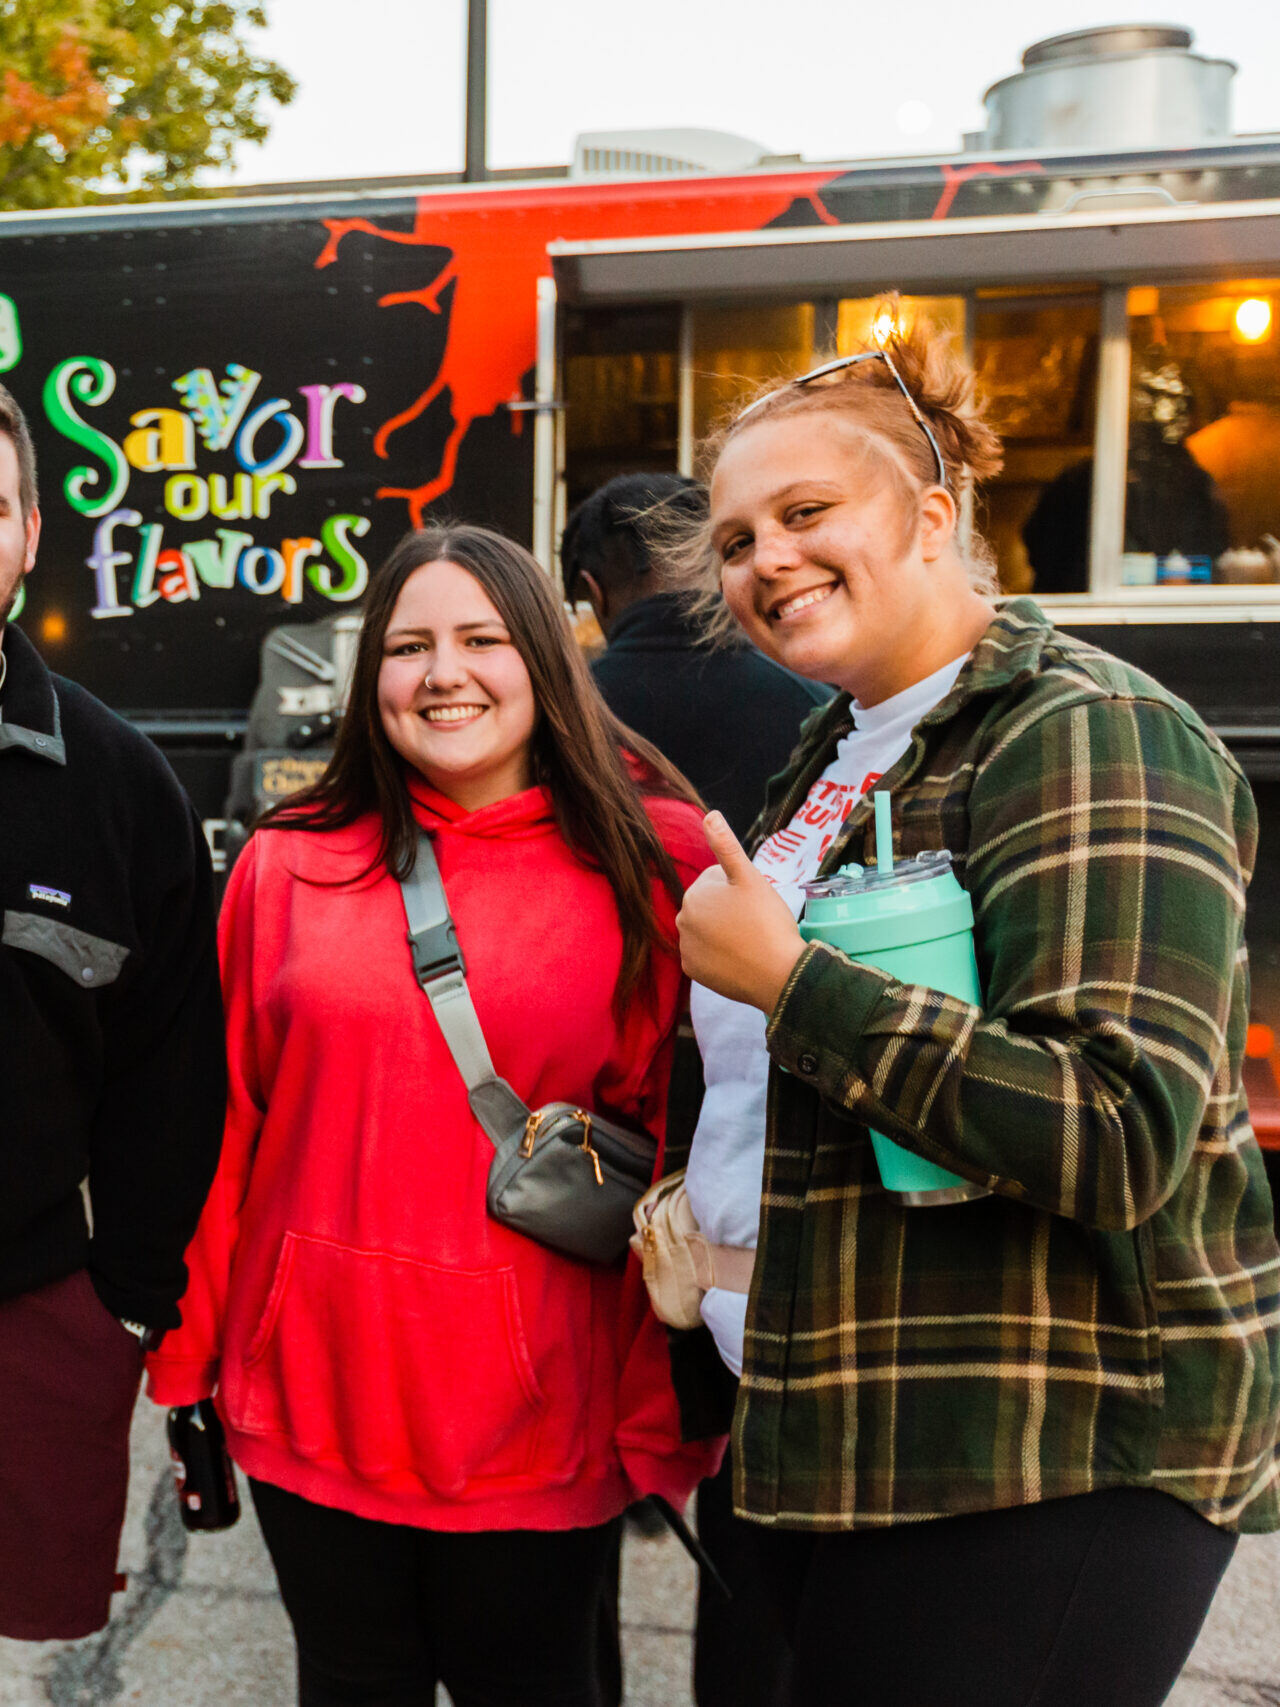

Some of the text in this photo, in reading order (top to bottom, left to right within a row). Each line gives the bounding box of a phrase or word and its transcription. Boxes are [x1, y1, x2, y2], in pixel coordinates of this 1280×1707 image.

[43, 356, 367, 518] Savor
[165, 472, 297, 521] our
[86, 508, 371, 619] flavors
